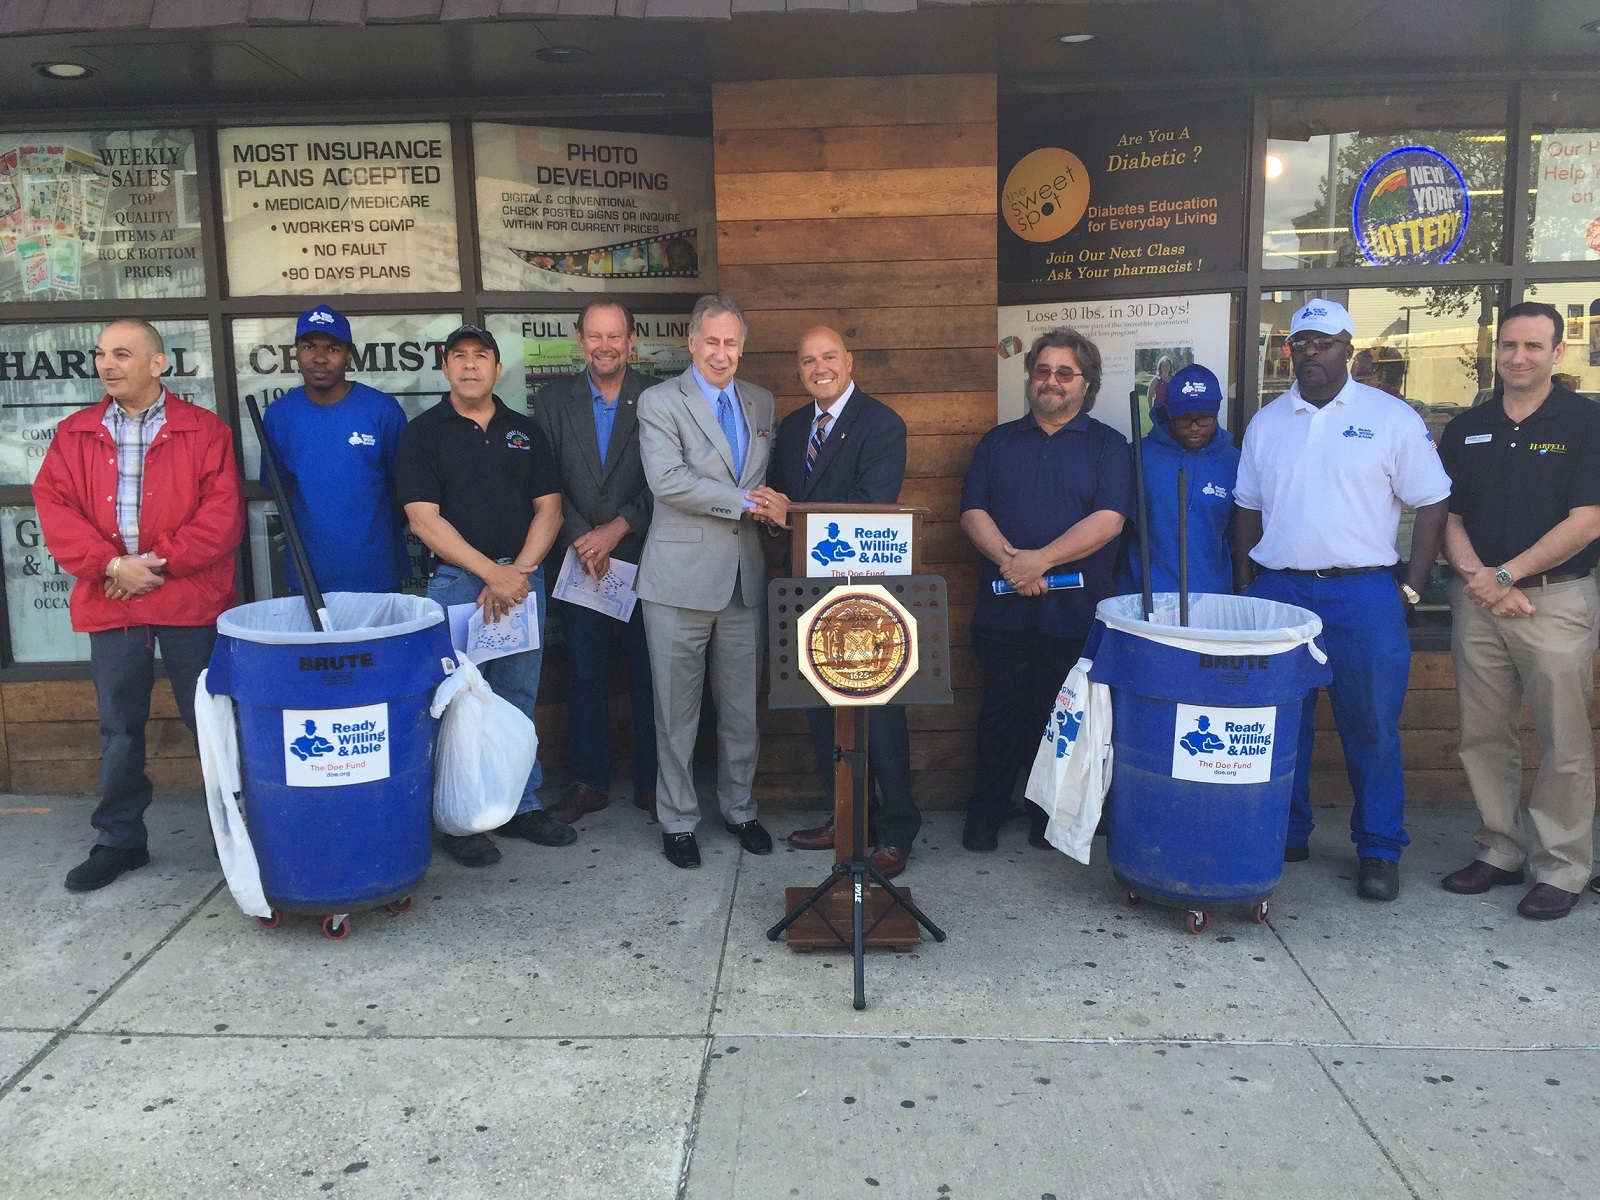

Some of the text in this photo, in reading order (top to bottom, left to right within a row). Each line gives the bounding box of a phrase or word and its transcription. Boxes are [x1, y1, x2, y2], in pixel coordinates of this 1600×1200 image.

[1117, 126, 1191, 147] Are You A
[99, 147, 180, 167] WEEKLY
[233, 139, 442, 163] MOST INSURANCE
[567, 142, 638, 165] PHOTO
[1547, 141, 1582, 157] Our
[1105, 145, 1203, 173] Diabetic ?
[111, 169, 171, 188] SALES
[238, 165, 441, 188] PLANS ACCEPTED
[537, 166, 668, 191] DEVELOPING
[1410, 165, 1445, 186] NEW
[1544, 163, 1586, 185] Help
[129, 193, 156, 206] TOP
[1005, 185, 1027, 203] the
[1011, 165, 1077, 218] sweet
[1413, 186, 1456, 213] YORK
[1571, 191, 1594, 204] on
[265, 195, 430, 212] MEDICAID/MEDICARE
[501, 192, 638, 209] DIGITAL & CONVENTIONAL
[1088, 197, 1218, 219] Diabetes Education
[115, 211, 173, 226] QUALITY
[502, 206, 681, 223] CHECK POSTED SIGNS OR INQUIRE
[1088, 211, 1218, 233] for Everyday Living
[282, 218, 415, 234] WORKER'S COMP
[503, 219, 660, 235] WITHIN FOR CURRENT PRICES
[115, 229, 176, 243] ITEMS AT
[1370, 211, 1461, 258] LOTTERY
[98, 246, 196, 261] ROCK BOTTOM
[314, 243, 387, 257] NO FAULT
[1045, 243, 1186, 265] Join Our Next Class
[125, 265, 173, 278] PRICES
[315, 266, 355, 280] DAYS
[360, 265, 411, 279] PLANS
[1046, 268, 1072, 282] Ask
[1077, 265, 1109, 279] Your
[1113, 260, 1192, 279] pharmacist
[1026, 301, 1190, 323] Lose 30 lbs. in 30 Days!
[522, 321, 567, 338] FULL
[1091, 323, 1103, 331] part
[1112, 321, 1122, 329] this
[1123, 320, 1153, 328] incredible
[1154, 318, 1189, 327] guaranteed
[249, 341, 447, 375] CHMIST
[854, 527, 899, 541] Ready
[860, 540, 908, 554] Willing
[22, 554, 42, 576] &
[858, 552, 903, 564] & Able
[831, 569, 885, 577] The Doe Fund
[43, 580, 69, 592] FOR
[34, 598, 69, 609] OCCA
[299, 653, 374, 671] BRUTE
[1199, 654, 1269, 670] BRUTE
[849, 671, 869, 680] 1625
[332, 720, 377, 734] Ready
[1225, 721, 1266, 734] Ready
[338, 729, 386, 746] Willing
[1229, 733, 1272, 746] Willing
[338, 743, 382, 757] & Able
[1227, 745, 1267, 756] & Able
[310, 761, 366, 772] The Doe Fund
[1199, 760, 1213, 768] The
[1215, 761, 1232, 769] Doe
[1213, 769, 1237, 777] doe.org
